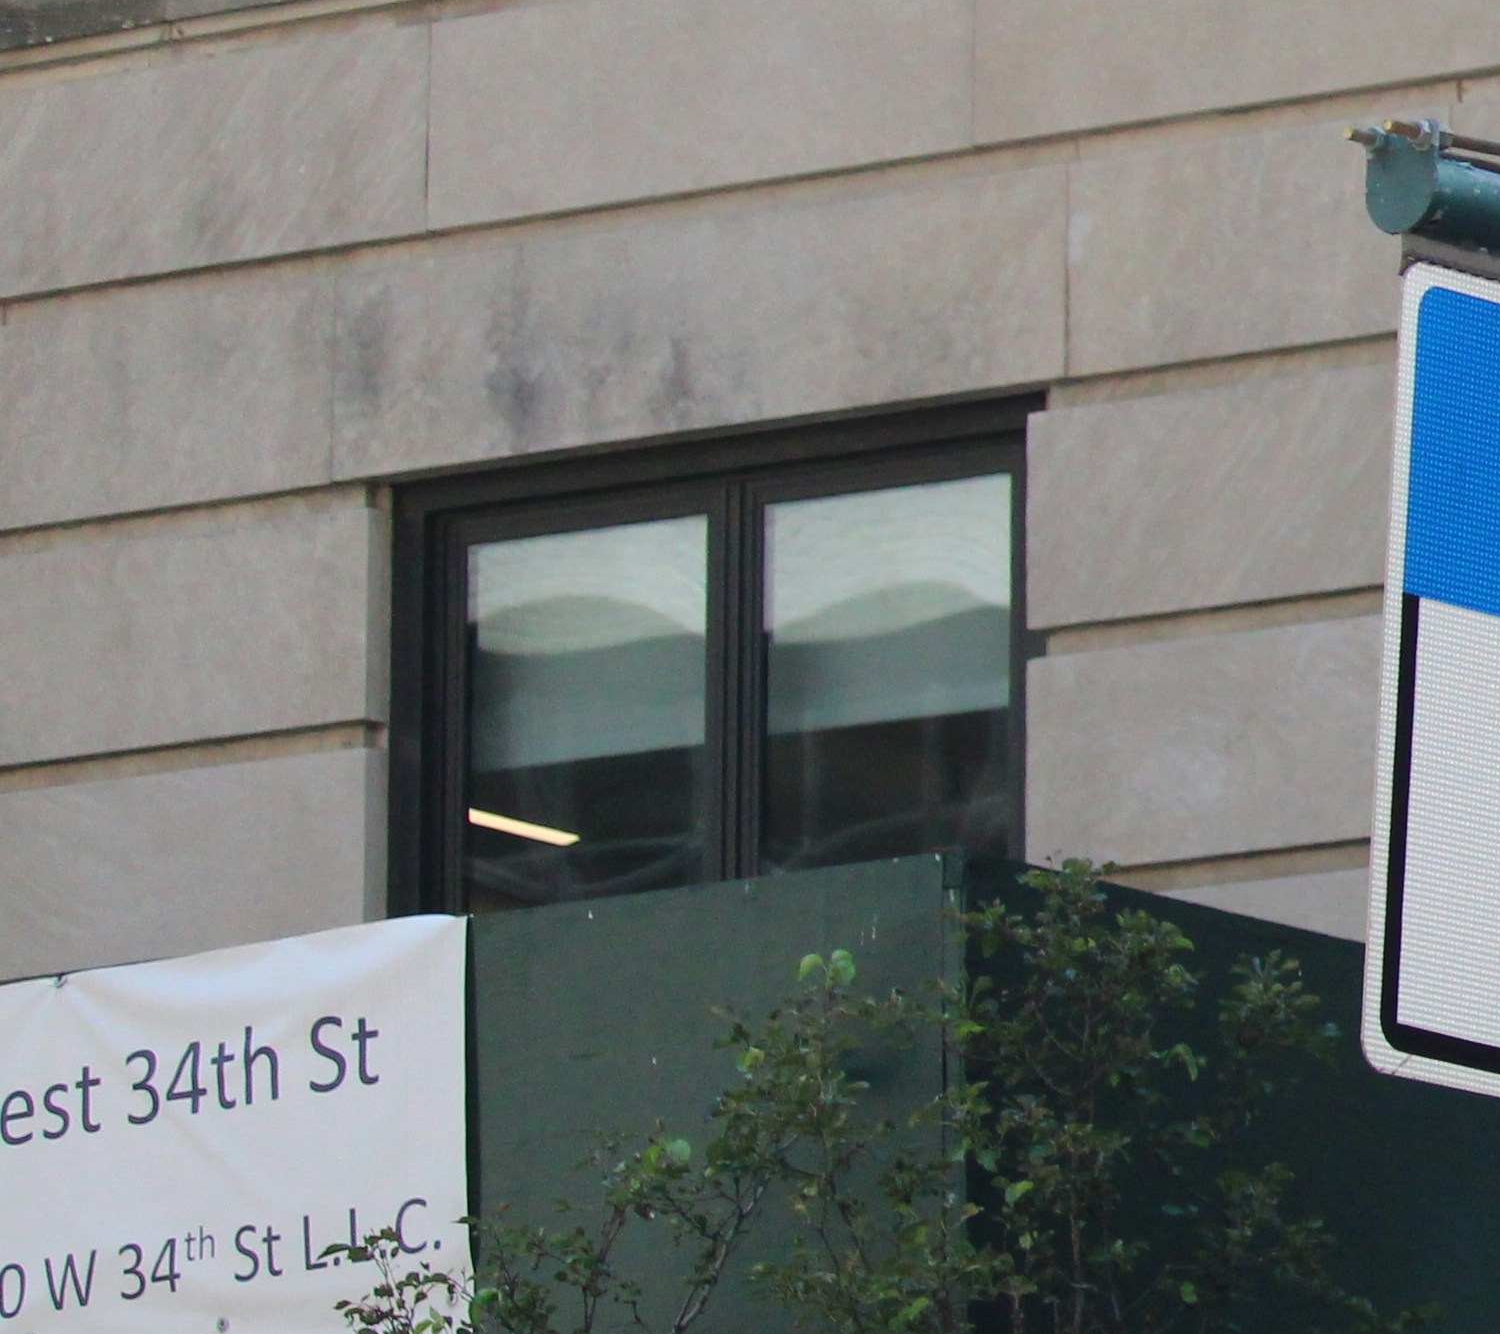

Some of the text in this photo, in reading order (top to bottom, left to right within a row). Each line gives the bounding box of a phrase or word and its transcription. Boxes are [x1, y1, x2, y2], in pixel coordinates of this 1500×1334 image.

[125, 1025, 280, 1125] 34th
[309, 1015, 380, 1094] St
[44, 1249, 97, 1311] W
[118, 1225, 216, 1301] 34th
[233, 1224, 283, 1283] St
